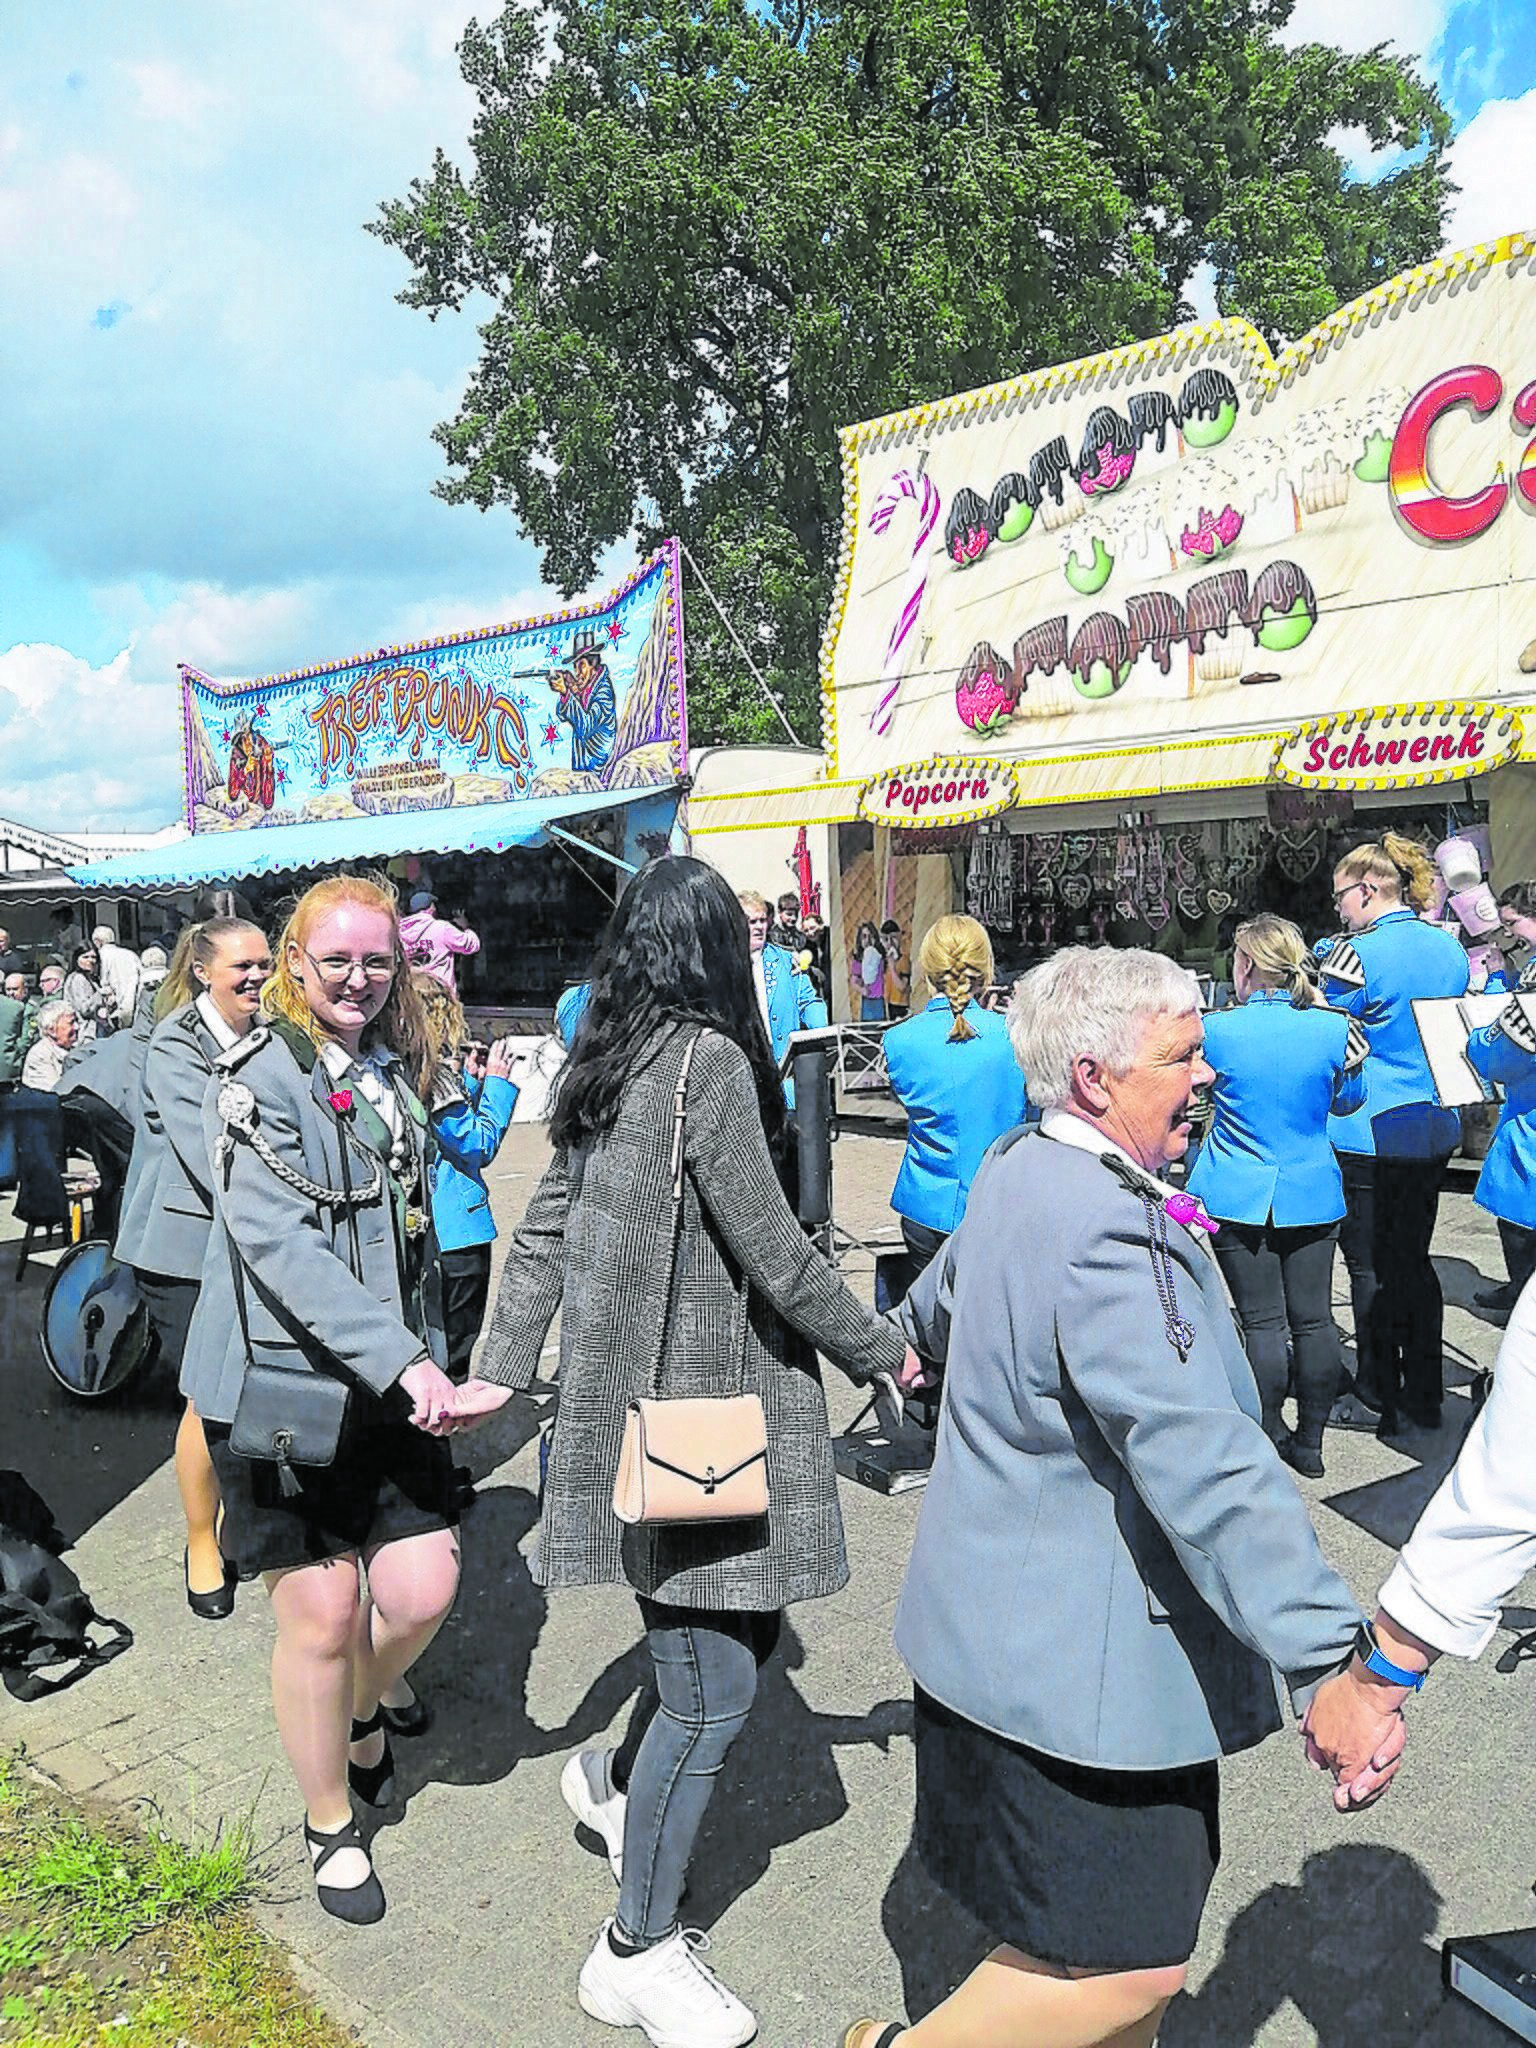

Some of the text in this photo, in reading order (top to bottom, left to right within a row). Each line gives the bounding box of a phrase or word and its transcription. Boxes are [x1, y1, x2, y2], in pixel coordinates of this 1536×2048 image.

[309, 666, 525, 769] TREFFPUNKT
[1303, 721, 1485, 773] Schwenk
[885, 778, 990, 815] Popcorn
